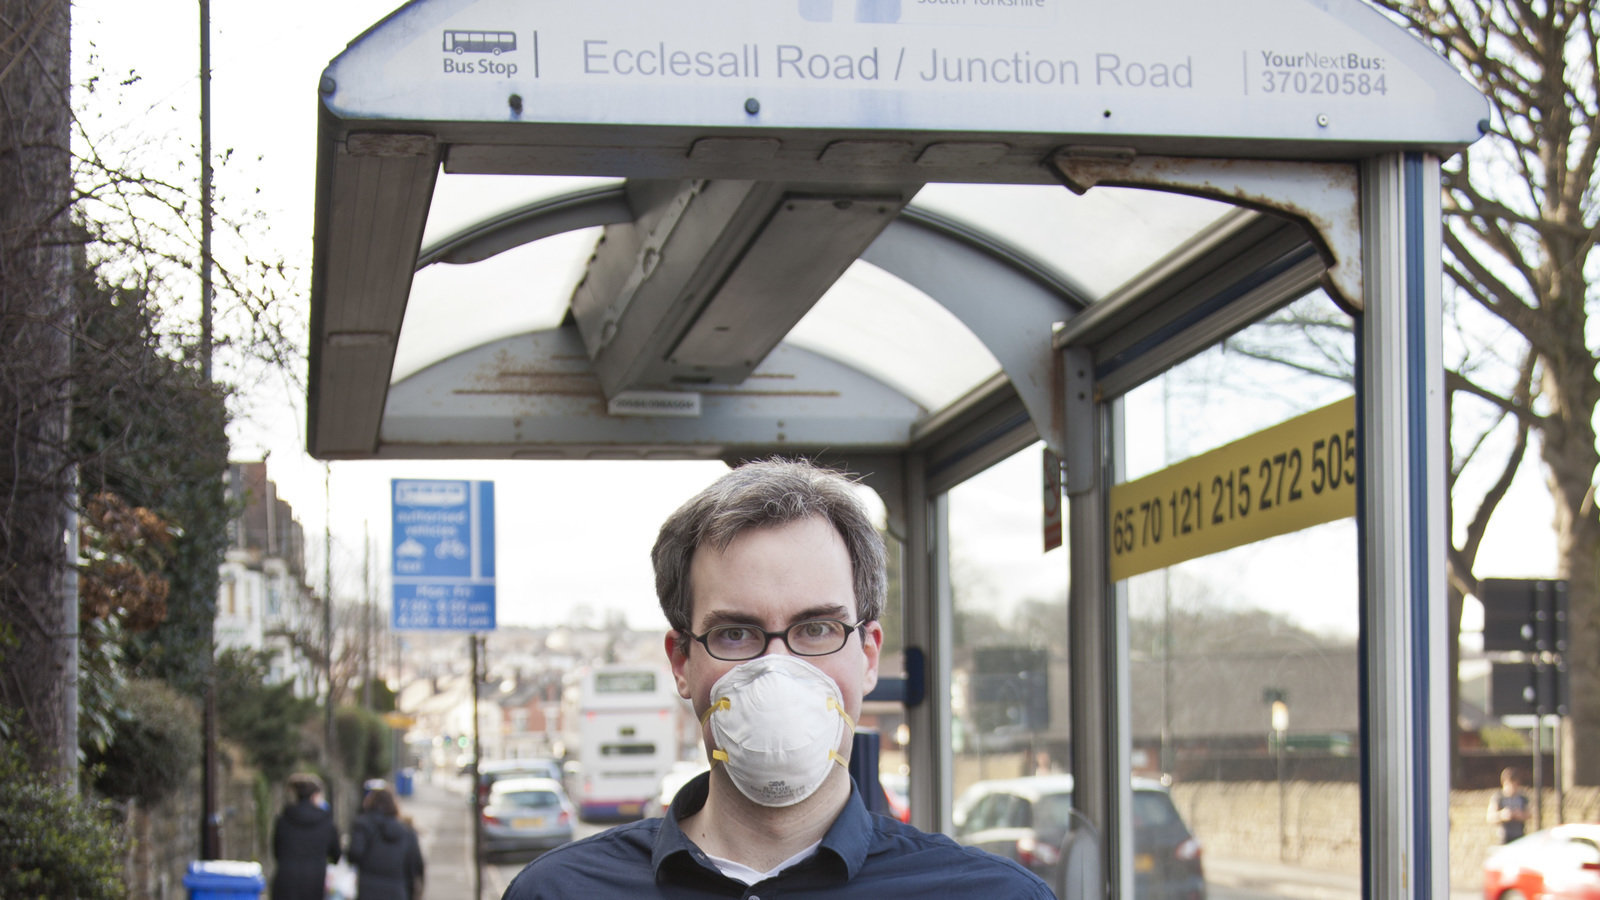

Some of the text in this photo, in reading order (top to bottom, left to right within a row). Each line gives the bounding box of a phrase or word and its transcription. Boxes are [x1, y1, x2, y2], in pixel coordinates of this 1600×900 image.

[443, 58, 518, 79] Bus Stop
[583, 40, 759, 78] Ecclesall
[776, 44, 879, 81] Road
[919, 49, 1079, 85] Junction
[1096, 53, 1193, 89] Road
[1262, 50, 1386, 70] YourNextBus:
[1262, 70, 1388, 96] 37020584
[1113, 428, 1355, 555] 65 70 121 215 272 505
